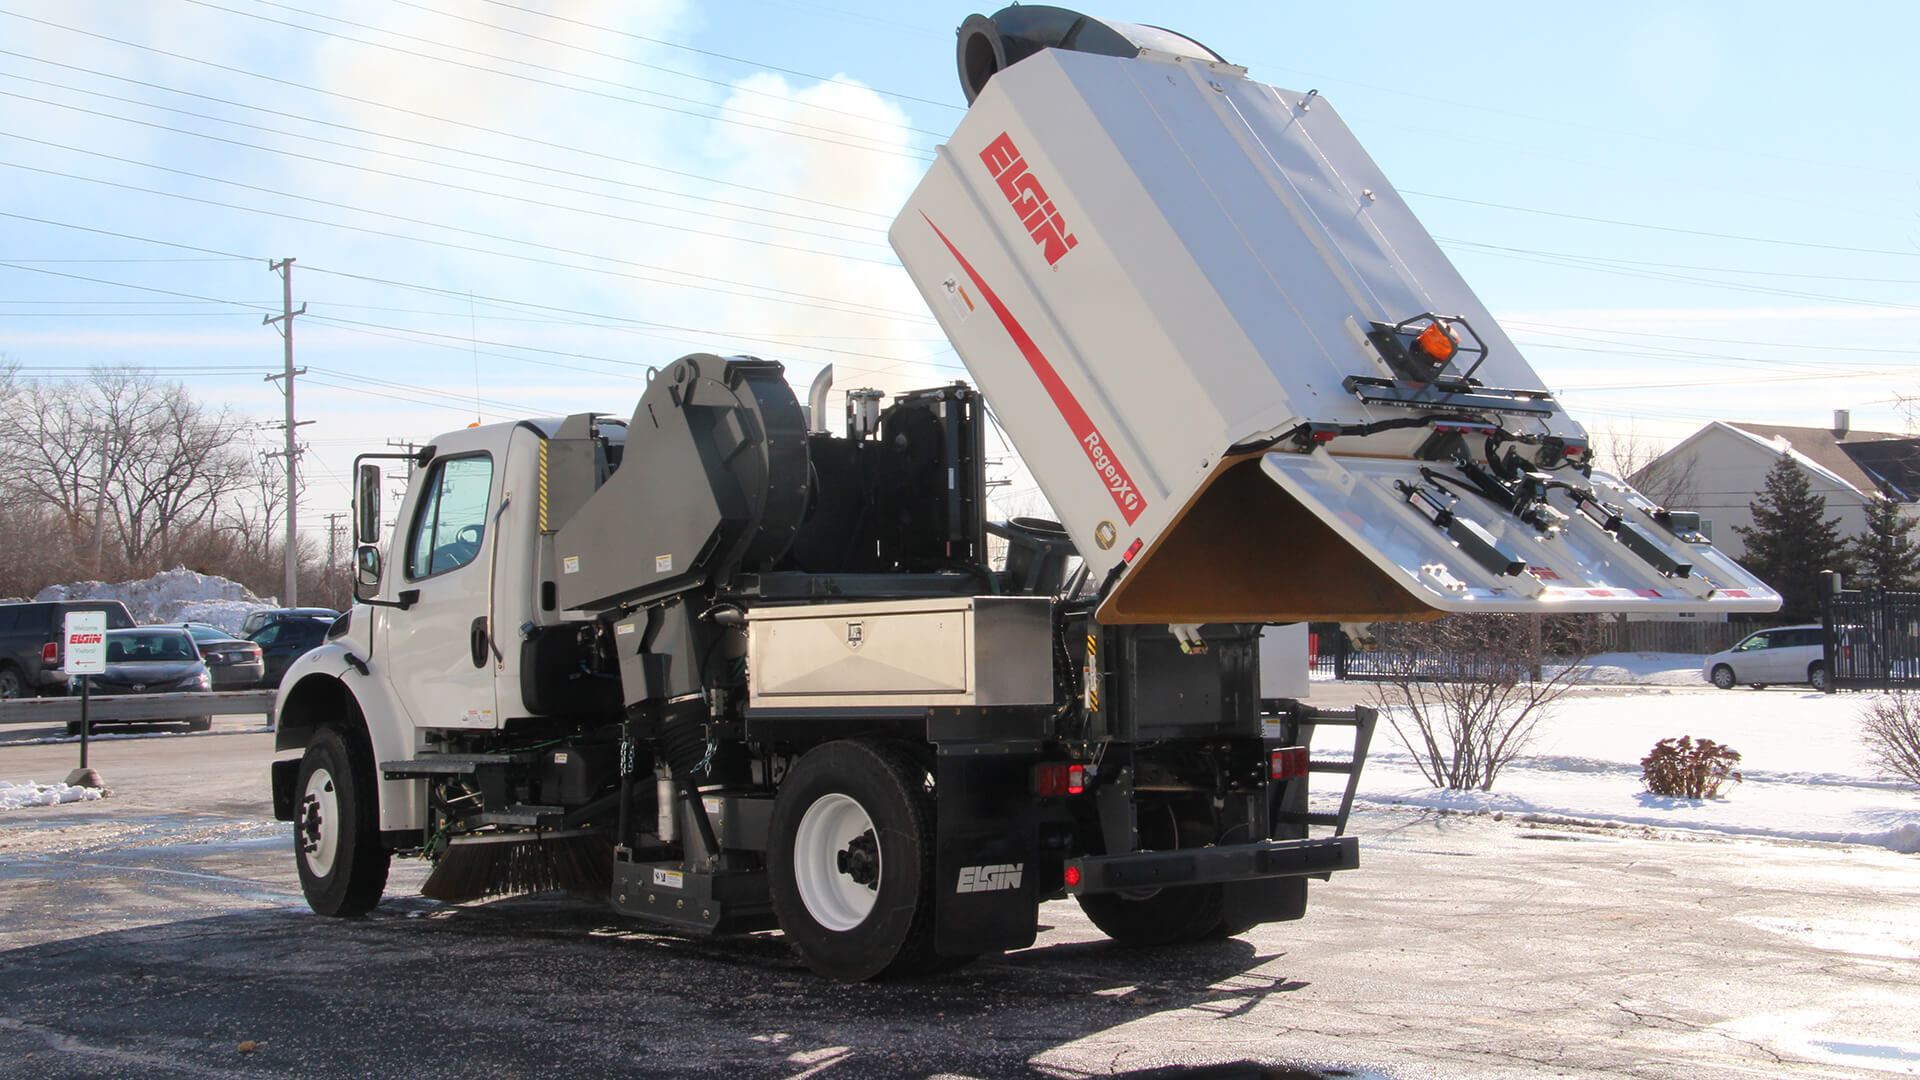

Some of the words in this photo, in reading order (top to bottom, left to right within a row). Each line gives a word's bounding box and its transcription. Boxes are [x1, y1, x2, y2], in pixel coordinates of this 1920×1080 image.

[979, 131, 1079, 266] ELGIN
[69, 633, 102, 645] ELGIN
[956, 862, 1024, 893] ELGIN
